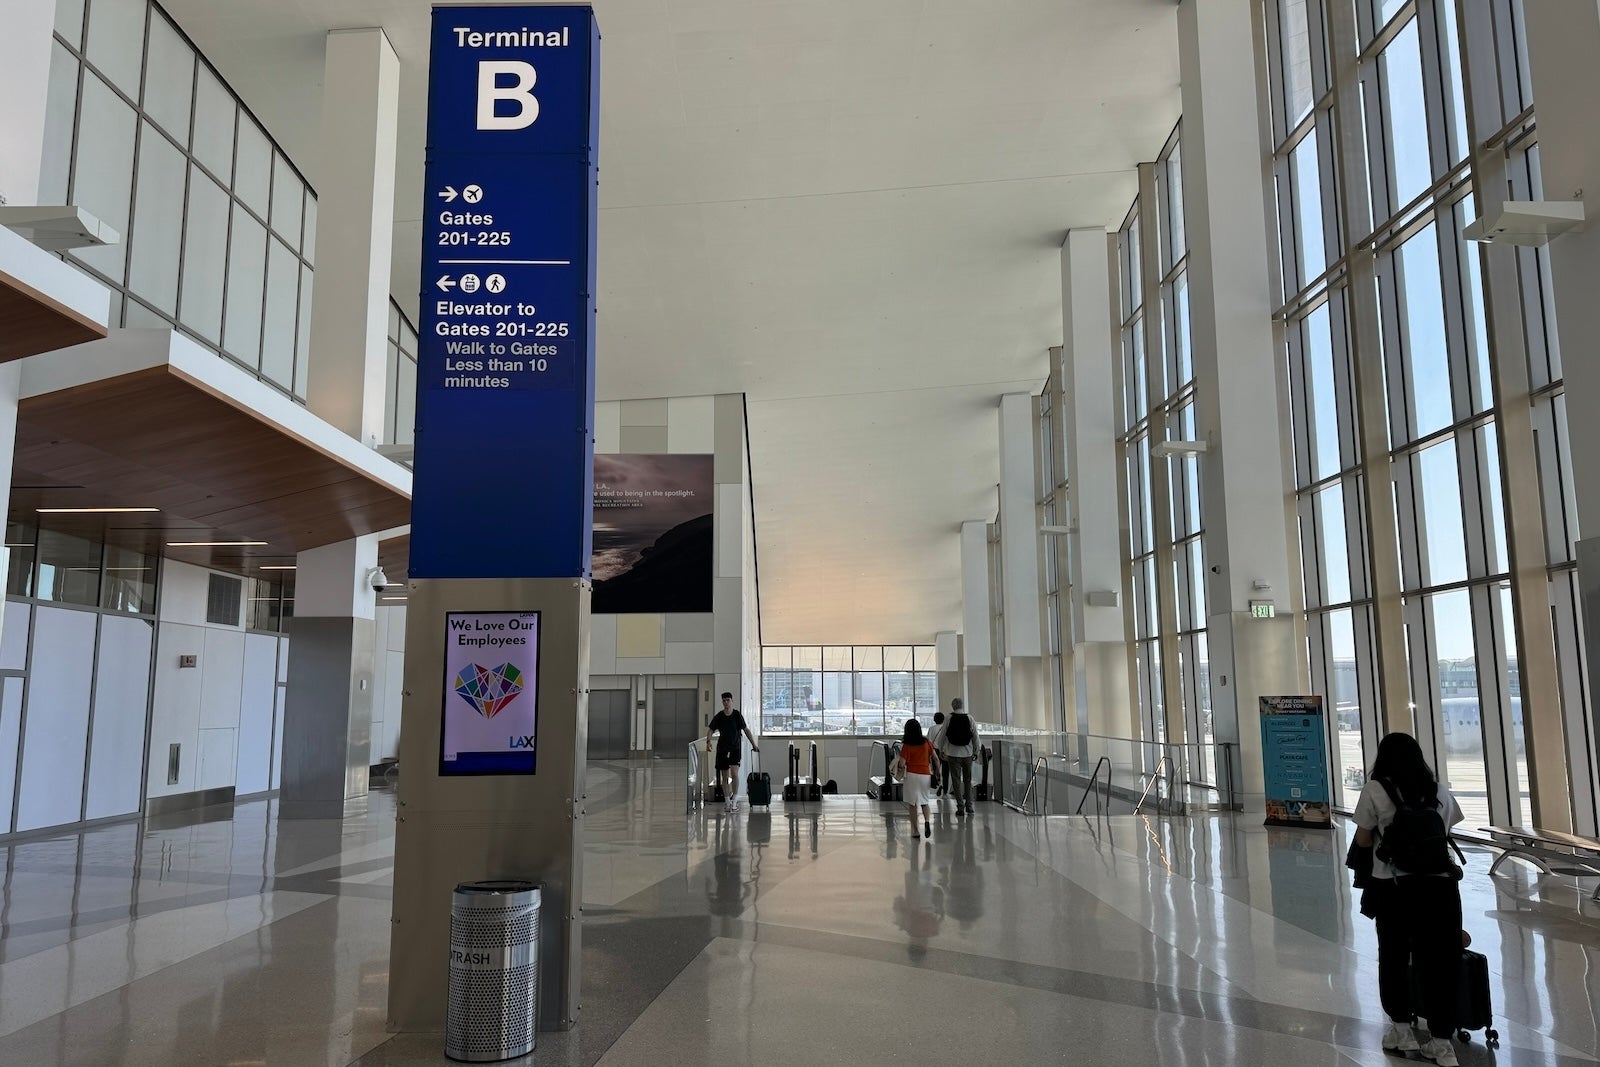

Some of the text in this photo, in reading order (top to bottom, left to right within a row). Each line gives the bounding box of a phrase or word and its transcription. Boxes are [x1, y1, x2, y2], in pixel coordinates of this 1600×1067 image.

[453, 27, 569, 47] Terminal
[476, 60, 540, 130] B
[439, 211, 493, 226] Gates
[438, 232, 511, 246] 201-225
[436, 301, 536, 316] Elevator to
[436, 321, 569, 337] Gates 201-225
[446, 341, 558, 356] Walk to Gates
[445, 358, 548, 372] Less than 10
[444, 374, 510, 388] minutes
[624, 490, 643, 498] being
[664, 489, 695, 498] spotlight.
[450, 618, 534, 631] We Love Our
[458, 633, 526, 649] Employees
[509, 735, 535, 749] LAX
[1285, 801, 1308, 814] LAX
[453, 950, 490, 965] TRASH
